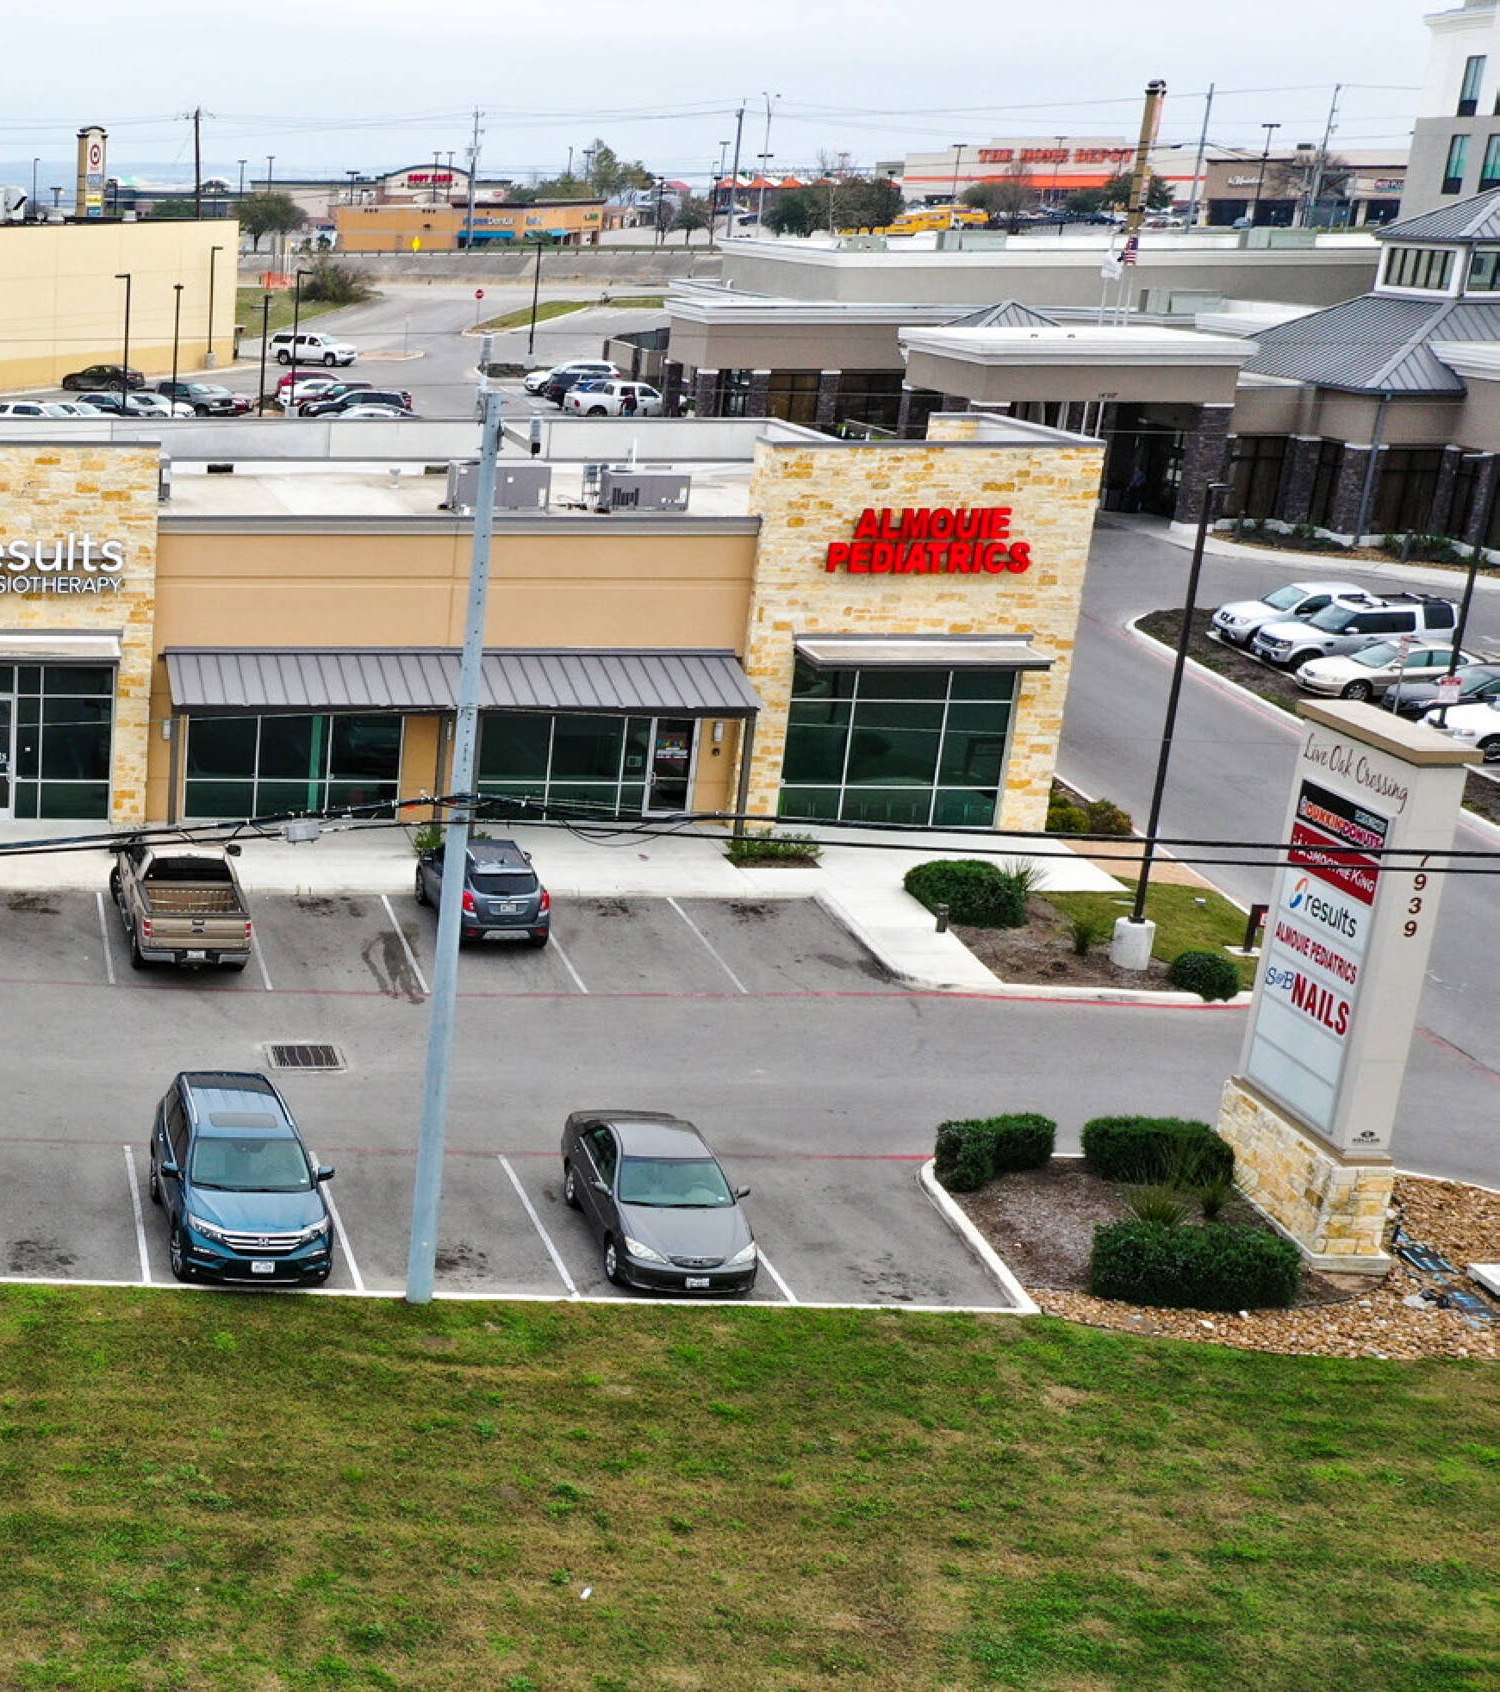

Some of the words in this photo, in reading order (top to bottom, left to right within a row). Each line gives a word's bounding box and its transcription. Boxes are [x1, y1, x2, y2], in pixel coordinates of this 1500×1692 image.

[979, 149, 1013, 163] THE
[1020, 148, 1069, 163] HOME
[1074, 148, 1135, 163] DEPOT
[854, 507, 1012, 540] ALMOUIE
[826, 542, 1030, 574] PEDIATRICS
[1303, 733, 1327, 766] Live
[1329, 745, 1354, 778] Oak
[1356, 755, 1409, 815] Crossing
[1304, 893, 1358, 938] results
[1403, 850, 1429, 938] 7939
[1275, 921, 1310, 956] ALMOUIE
[1311, 940, 1358, 985] PEDIATRICS
[1291, 973, 1350, 1036] NAILS
